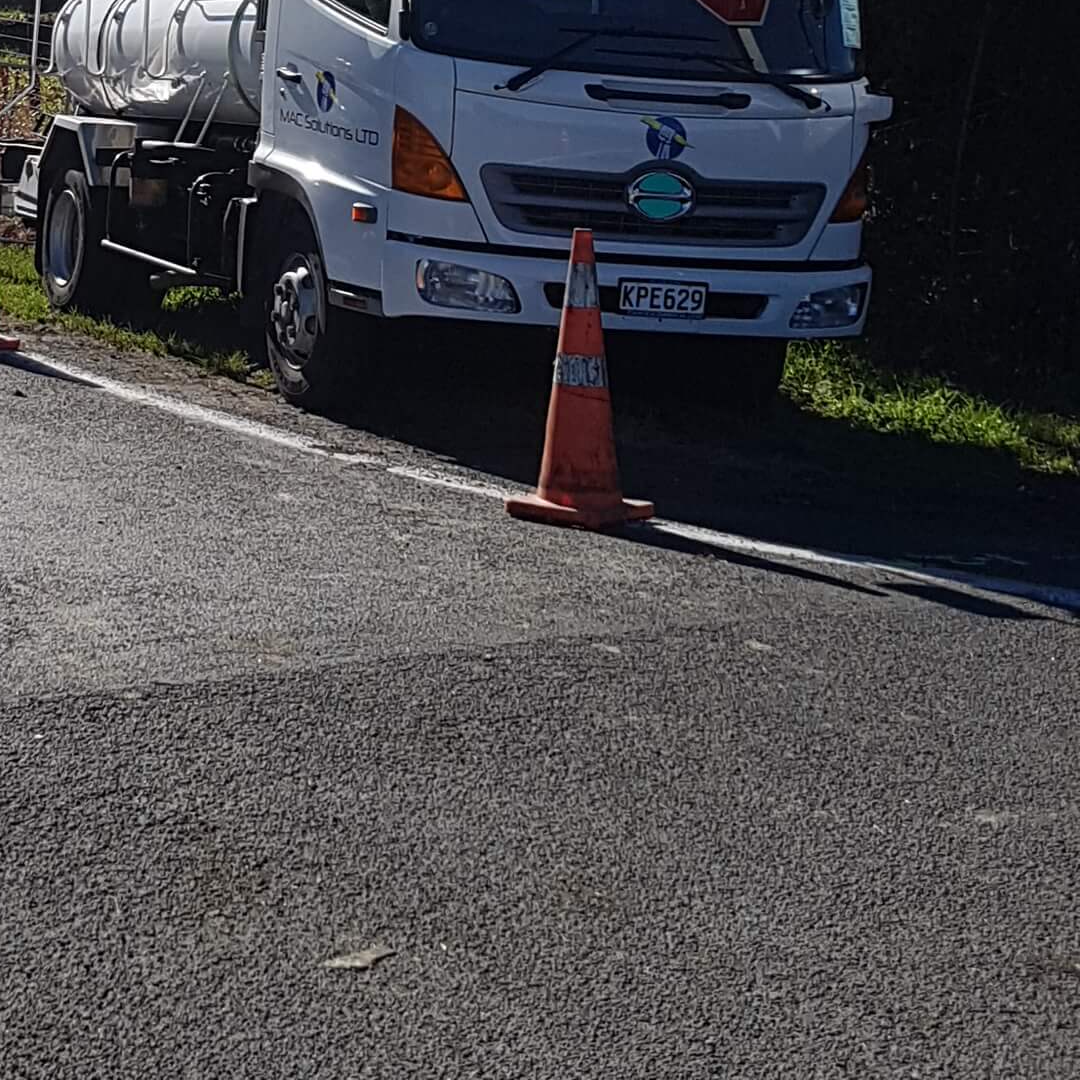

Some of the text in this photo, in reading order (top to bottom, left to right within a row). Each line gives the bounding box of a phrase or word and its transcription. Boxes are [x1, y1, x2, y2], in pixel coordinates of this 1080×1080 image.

[279, 108, 380, 146] MAC Solutions LTD
[623, 286, 703, 311] KPE629
